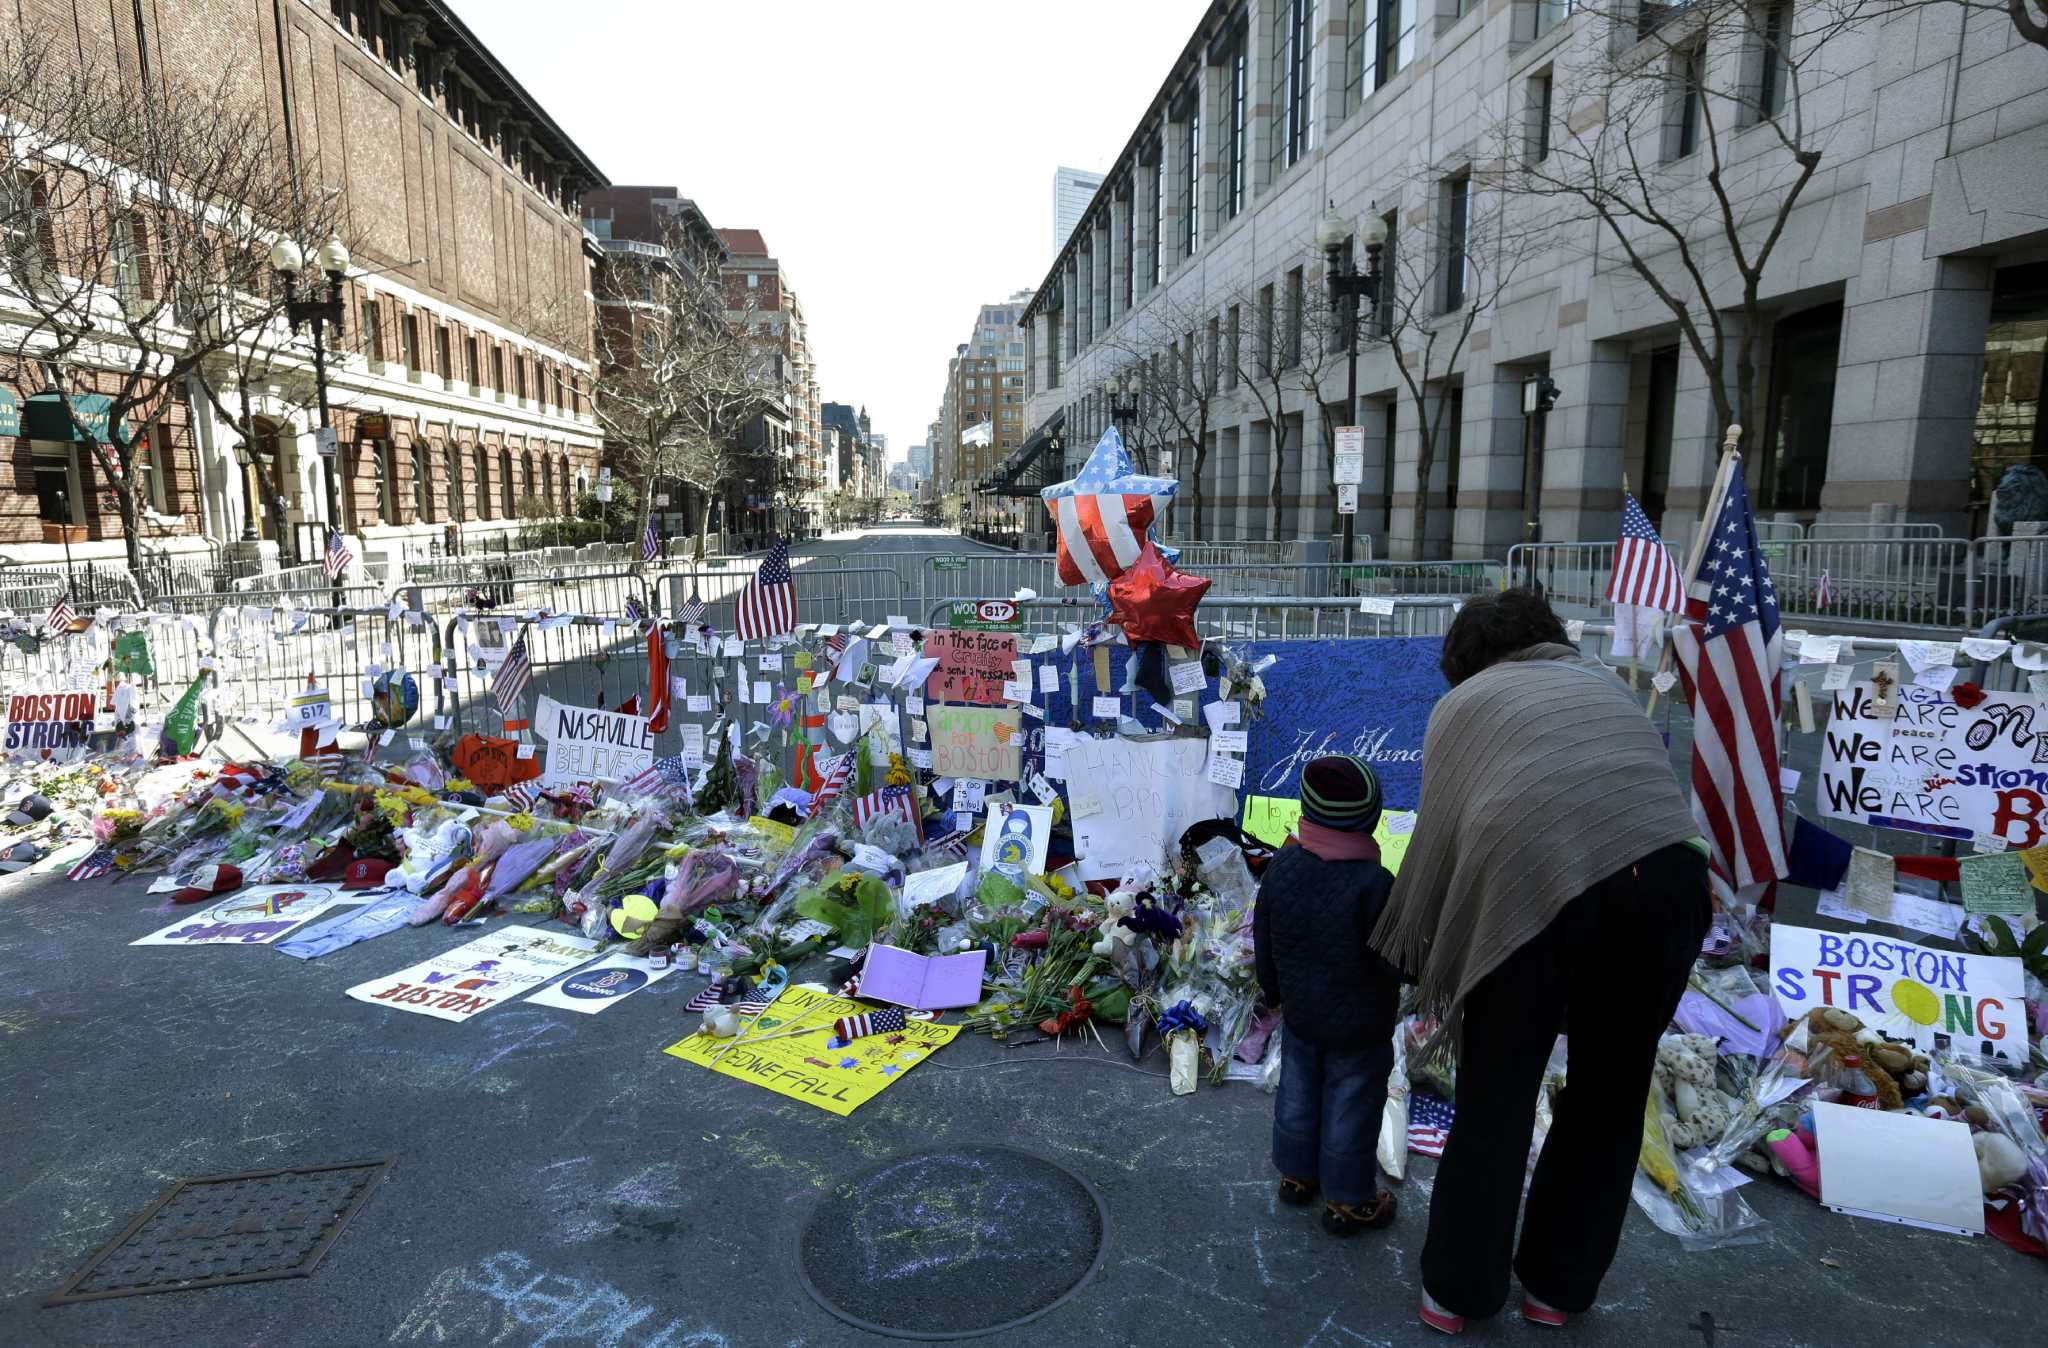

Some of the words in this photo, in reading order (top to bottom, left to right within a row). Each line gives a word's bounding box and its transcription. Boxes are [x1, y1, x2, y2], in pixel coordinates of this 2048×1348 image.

[953, 603, 977, 615] WOO
[934, 630, 945, 646] in
[949, 630, 975, 650] the
[976, 632, 1000, 652] face
[1000, 638, 1015, 652] of
[944, 677, 956, 690] of
[946, 665, 966, 676] send
[9, 693, 97, 723] BOSTON
[301, 703, 326, 720] 617
[5, 720, 96, 750] STRONG
[557, 708, 655, 752] NASHVILLE
[555, 743, 650, 778] BELIEVES
[1827, 731, 1882, 764] We
[1823, 766, 1883, 815] We
[1955, 763, 2048, 795] stron
[1817, 933, 1968, 993] BOSTON
[371, 982, 497, 1015] BOSTON
[567, 982, 617, 996] STRONG
[1775, 967, 2006, 1041] STRONG
[903, 1020, 950, 1039] AND
[746, 1056, 784, 1078] WE
[769, 1070, 850, 1102] FALL
